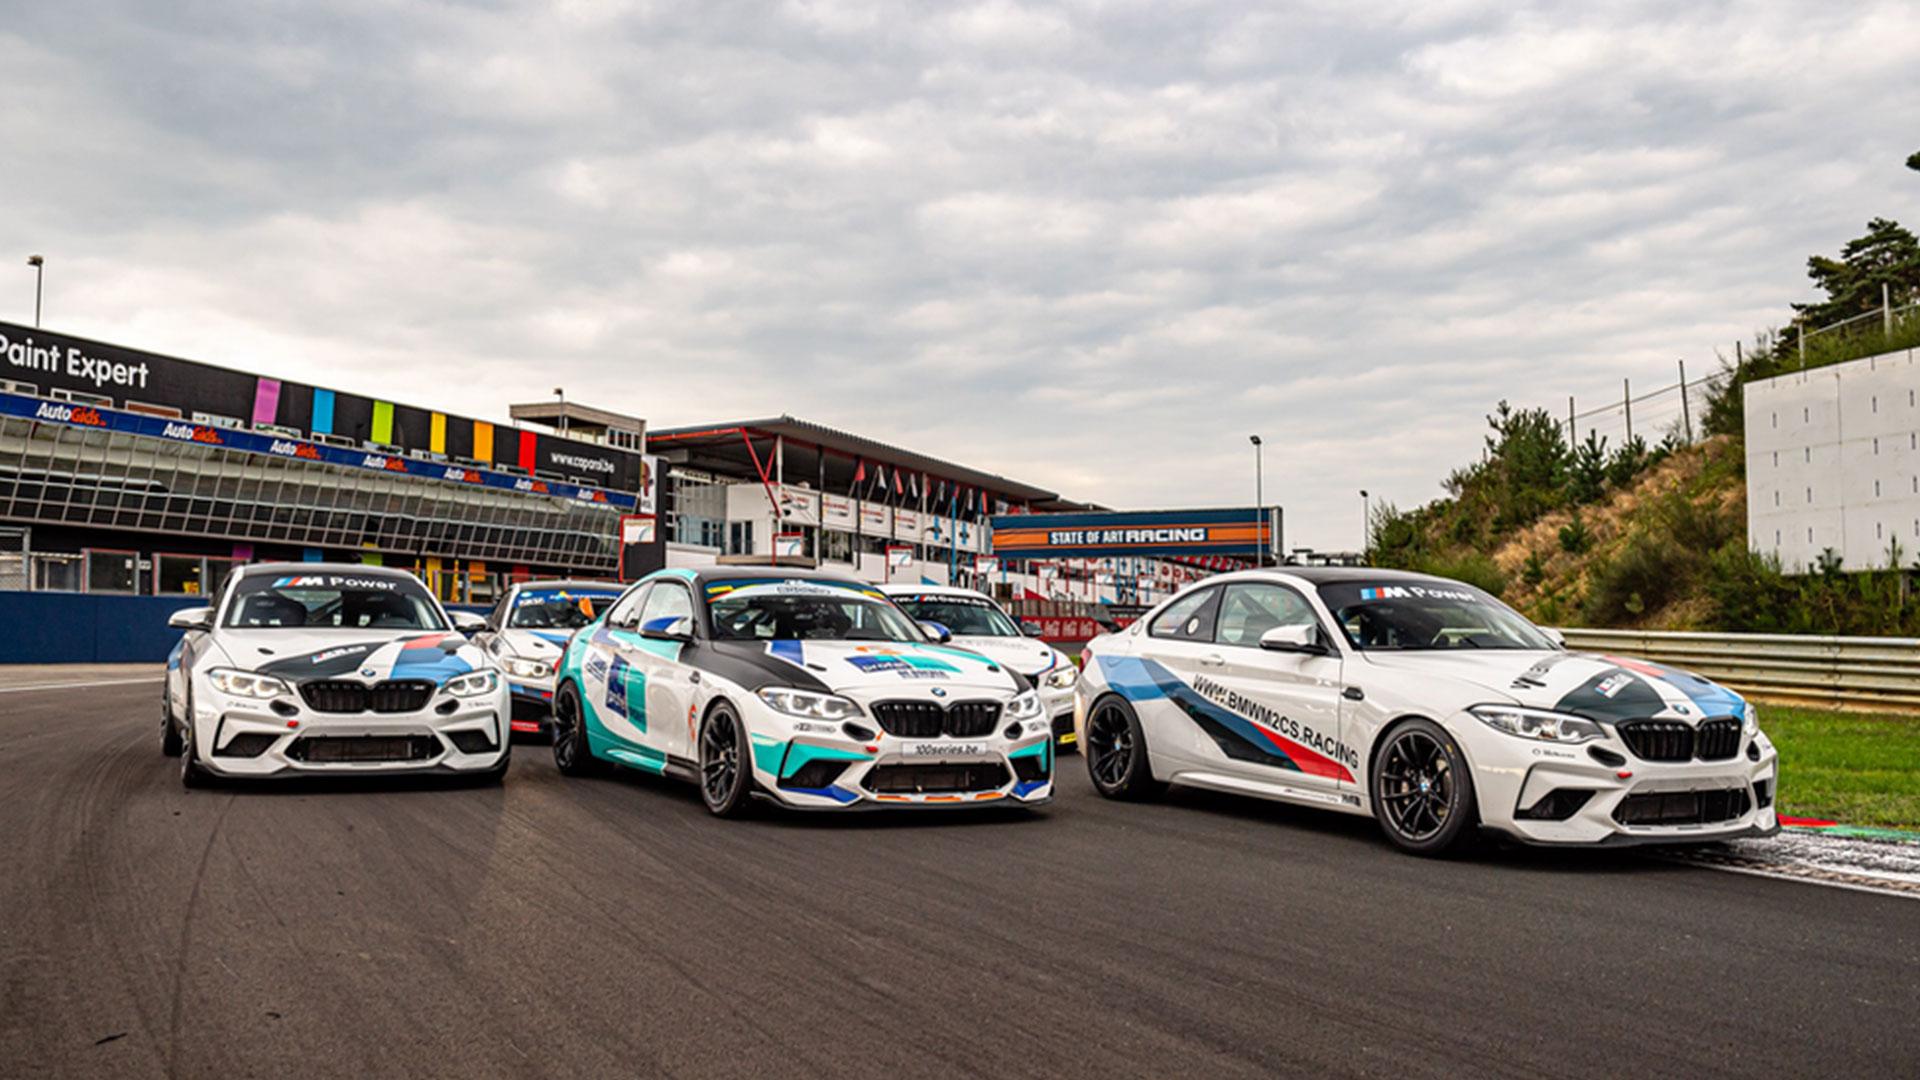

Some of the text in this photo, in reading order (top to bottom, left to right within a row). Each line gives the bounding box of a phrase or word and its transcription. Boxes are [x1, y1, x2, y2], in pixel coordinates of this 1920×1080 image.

[66, 347, 149, 388] Expert
[1050, 528, 1206, 545] STATE OF ART RACING
[330, 576, 397, 590] Power
[914, 743, 979, 756] 100series.be
